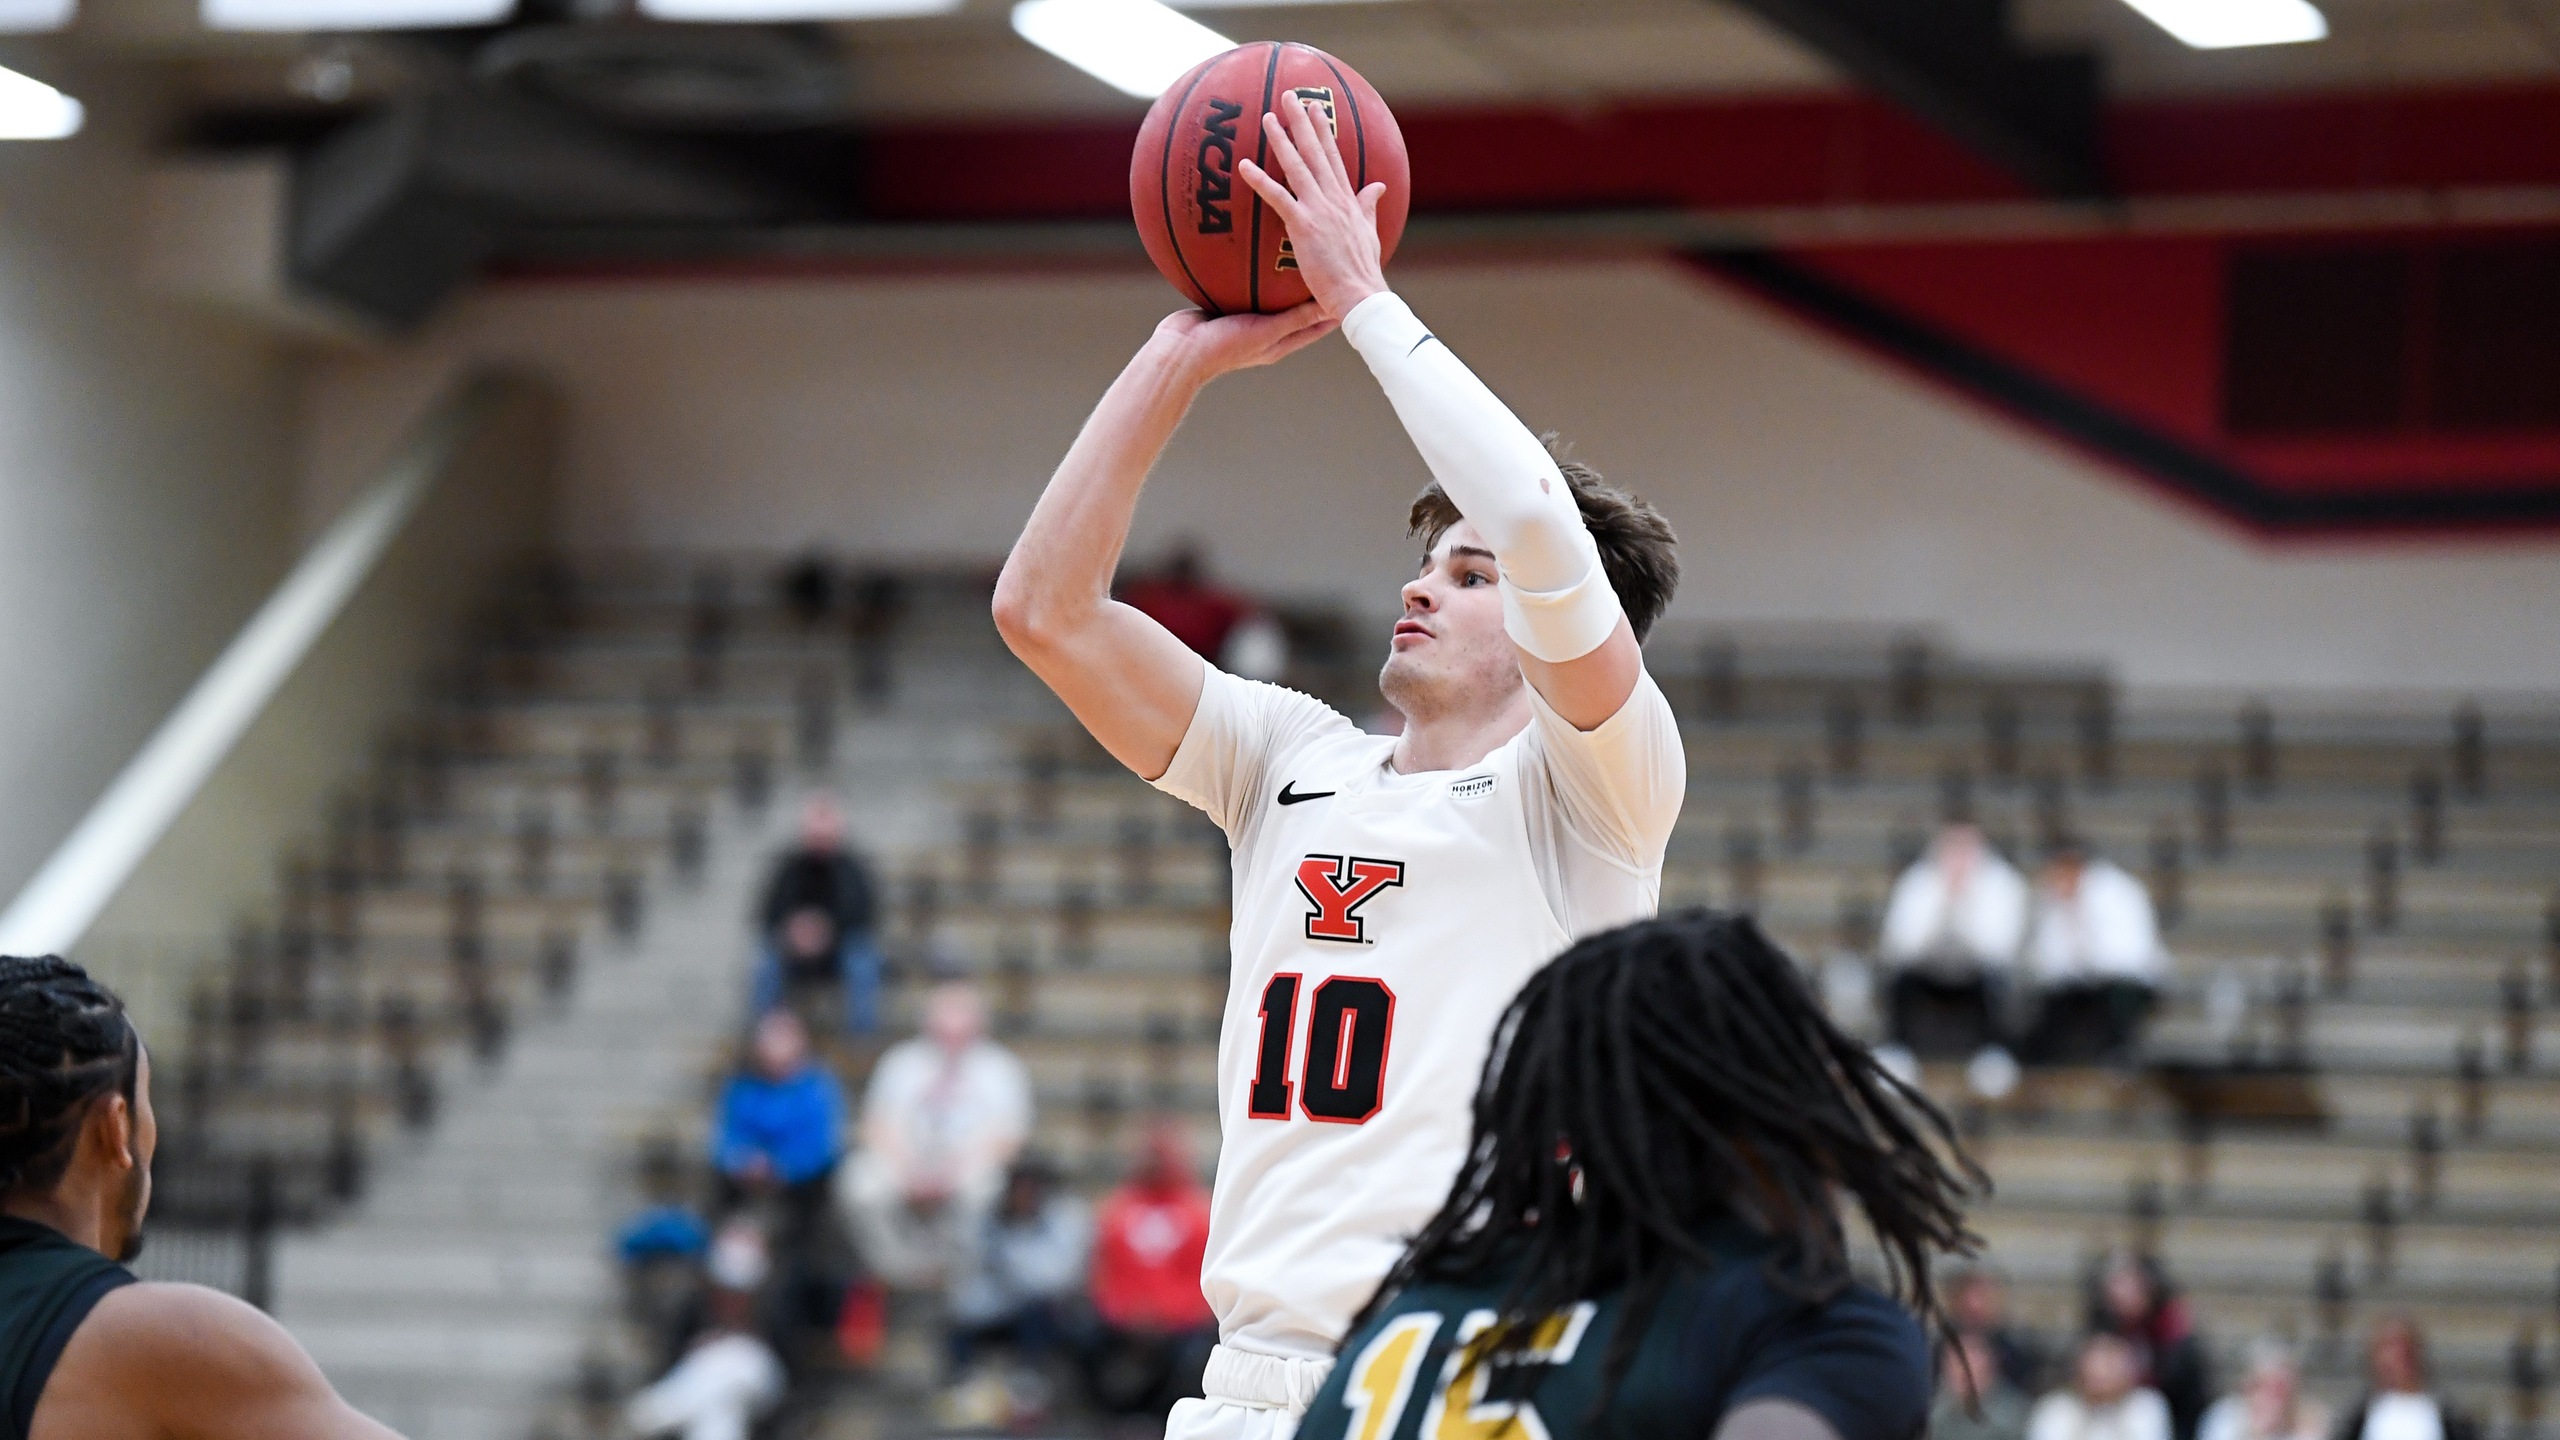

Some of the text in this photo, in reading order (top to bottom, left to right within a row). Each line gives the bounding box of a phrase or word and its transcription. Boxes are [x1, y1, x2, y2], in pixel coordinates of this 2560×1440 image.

[1197, 98, 1243, 234] NCAA
[1452, 778, 1493, 792] HORIZON
[1294, 853, 1406, 944] Y
[1248, 972, 1397, 1126] 10
